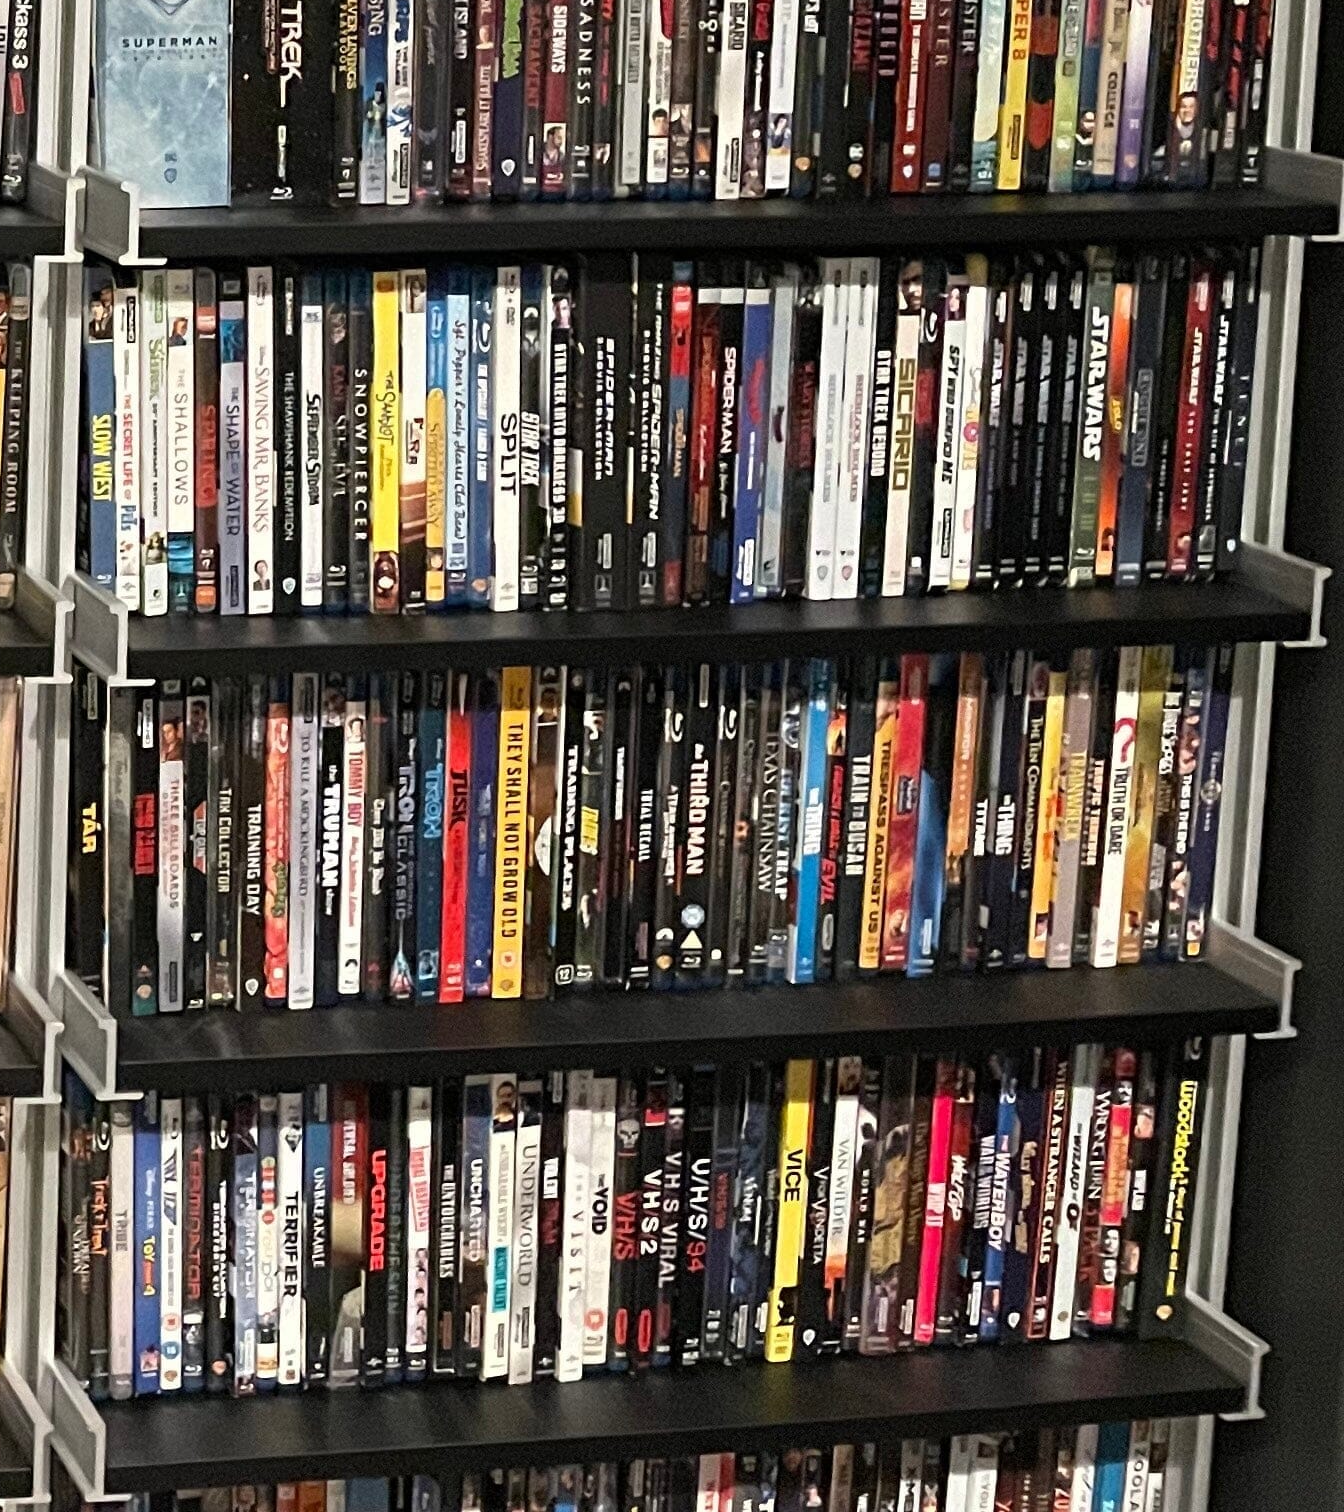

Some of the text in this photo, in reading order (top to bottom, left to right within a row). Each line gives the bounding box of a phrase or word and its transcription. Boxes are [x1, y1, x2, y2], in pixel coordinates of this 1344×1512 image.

[12, 54, 29, 69] 3
[121, 38, 219, 48] SUPERMAN
[281, 1, 302, 107] TREK
[550, 4, 567, 72] SIDEWAYS
[353, 368, 370, 541] SNOWPIERCER
[500, 412, 517, 495] SPLIT
[893, 358, 915, 491] SICARIO
[81, 803, 100, 853] TÁR
[451, 769, 468, 828] TUSK
[500, 723, 523, 938] THEY SHALL NOT GROW OLD
[1108, 767, 1130, 855] TRUTH OR DARE
[244, 804, 262, 915] TRAINING DAY
[370, 1149, 386, 1271] UPGRADE
[518, 1144, 537, 1286] UNDERWORLD
[784, 1149, 802, 1203] VICE
[283, 1191, 300, 1299] TERRIFIER
